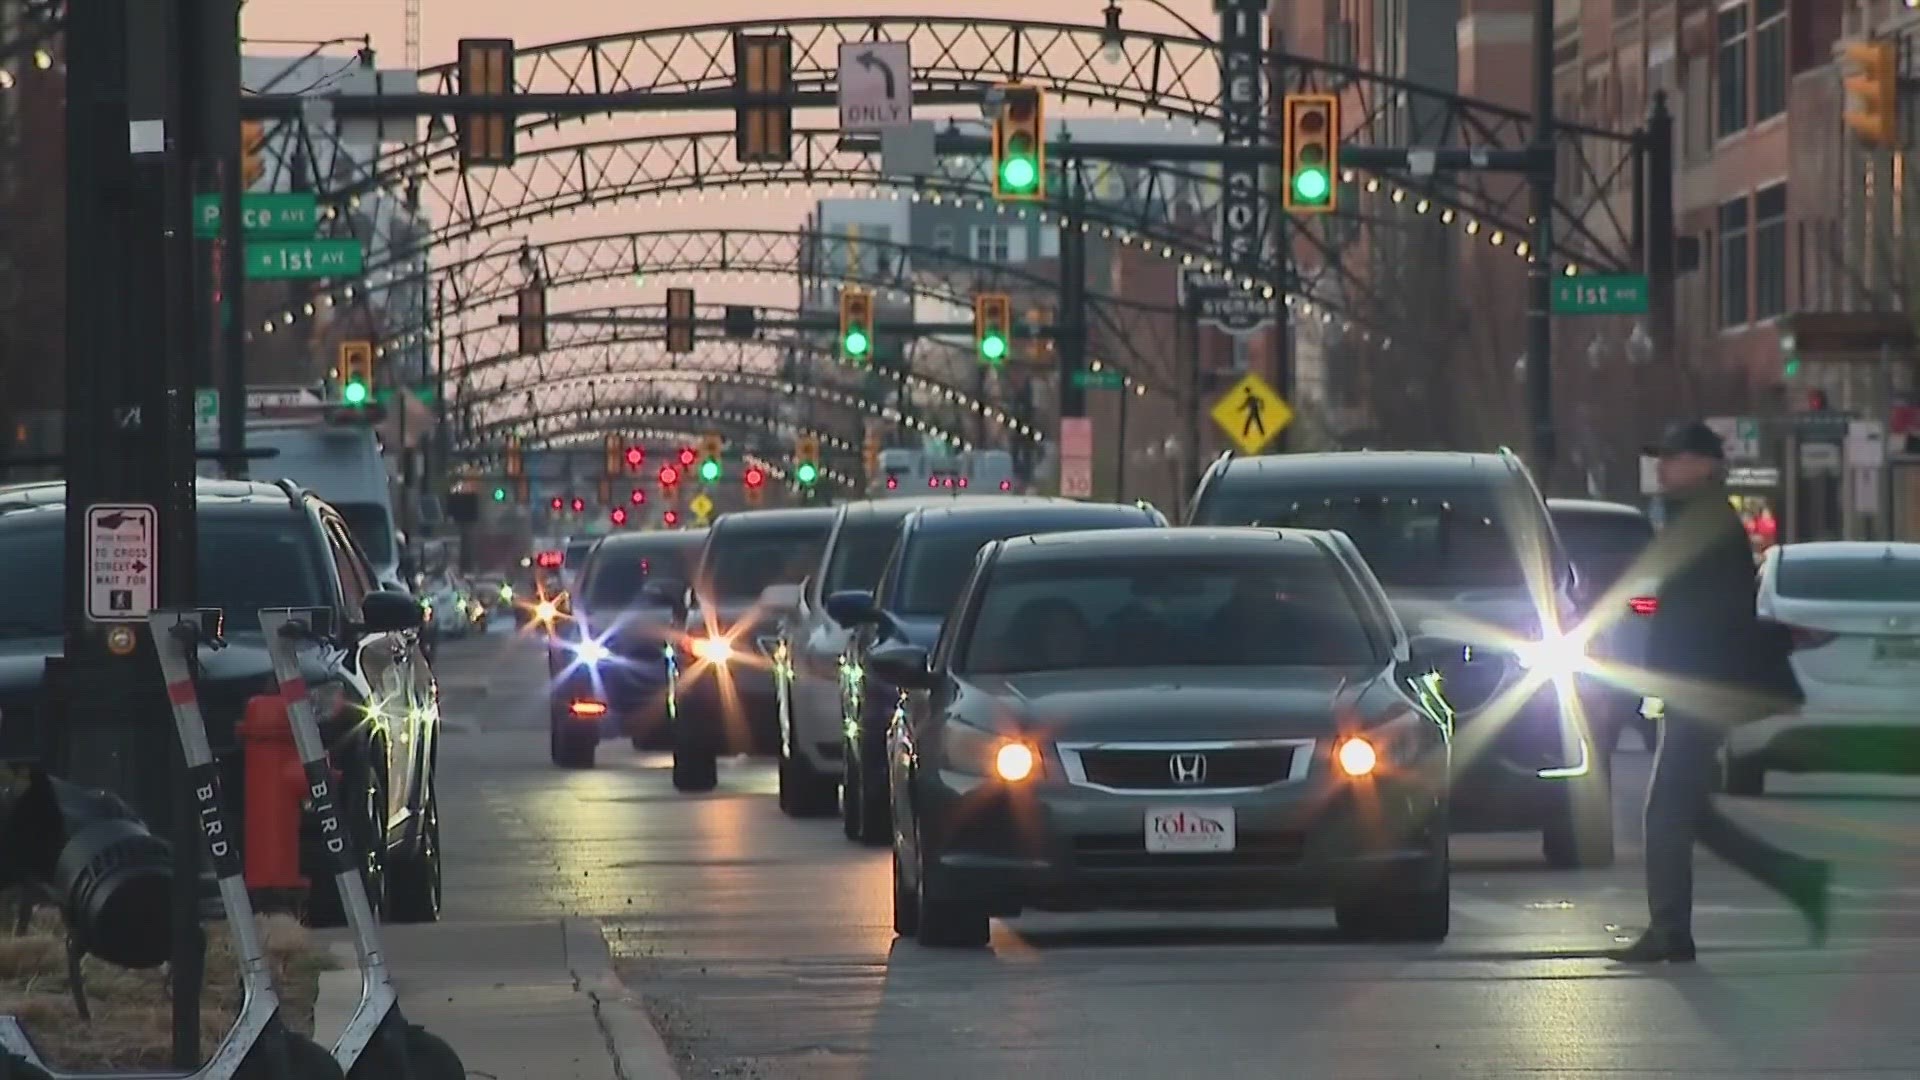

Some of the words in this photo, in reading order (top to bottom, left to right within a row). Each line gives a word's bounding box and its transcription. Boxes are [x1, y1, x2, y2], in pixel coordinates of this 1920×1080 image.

[848, 104, 903, 122] ONLY
[280, 248, 314, 271] 1st
[321, 251, 345, 265] AVE
[1576, 284, 1608, 305] 1st
[196, 783, 228, 857] BIRD
[312, 780, 344, 853] BIRD
